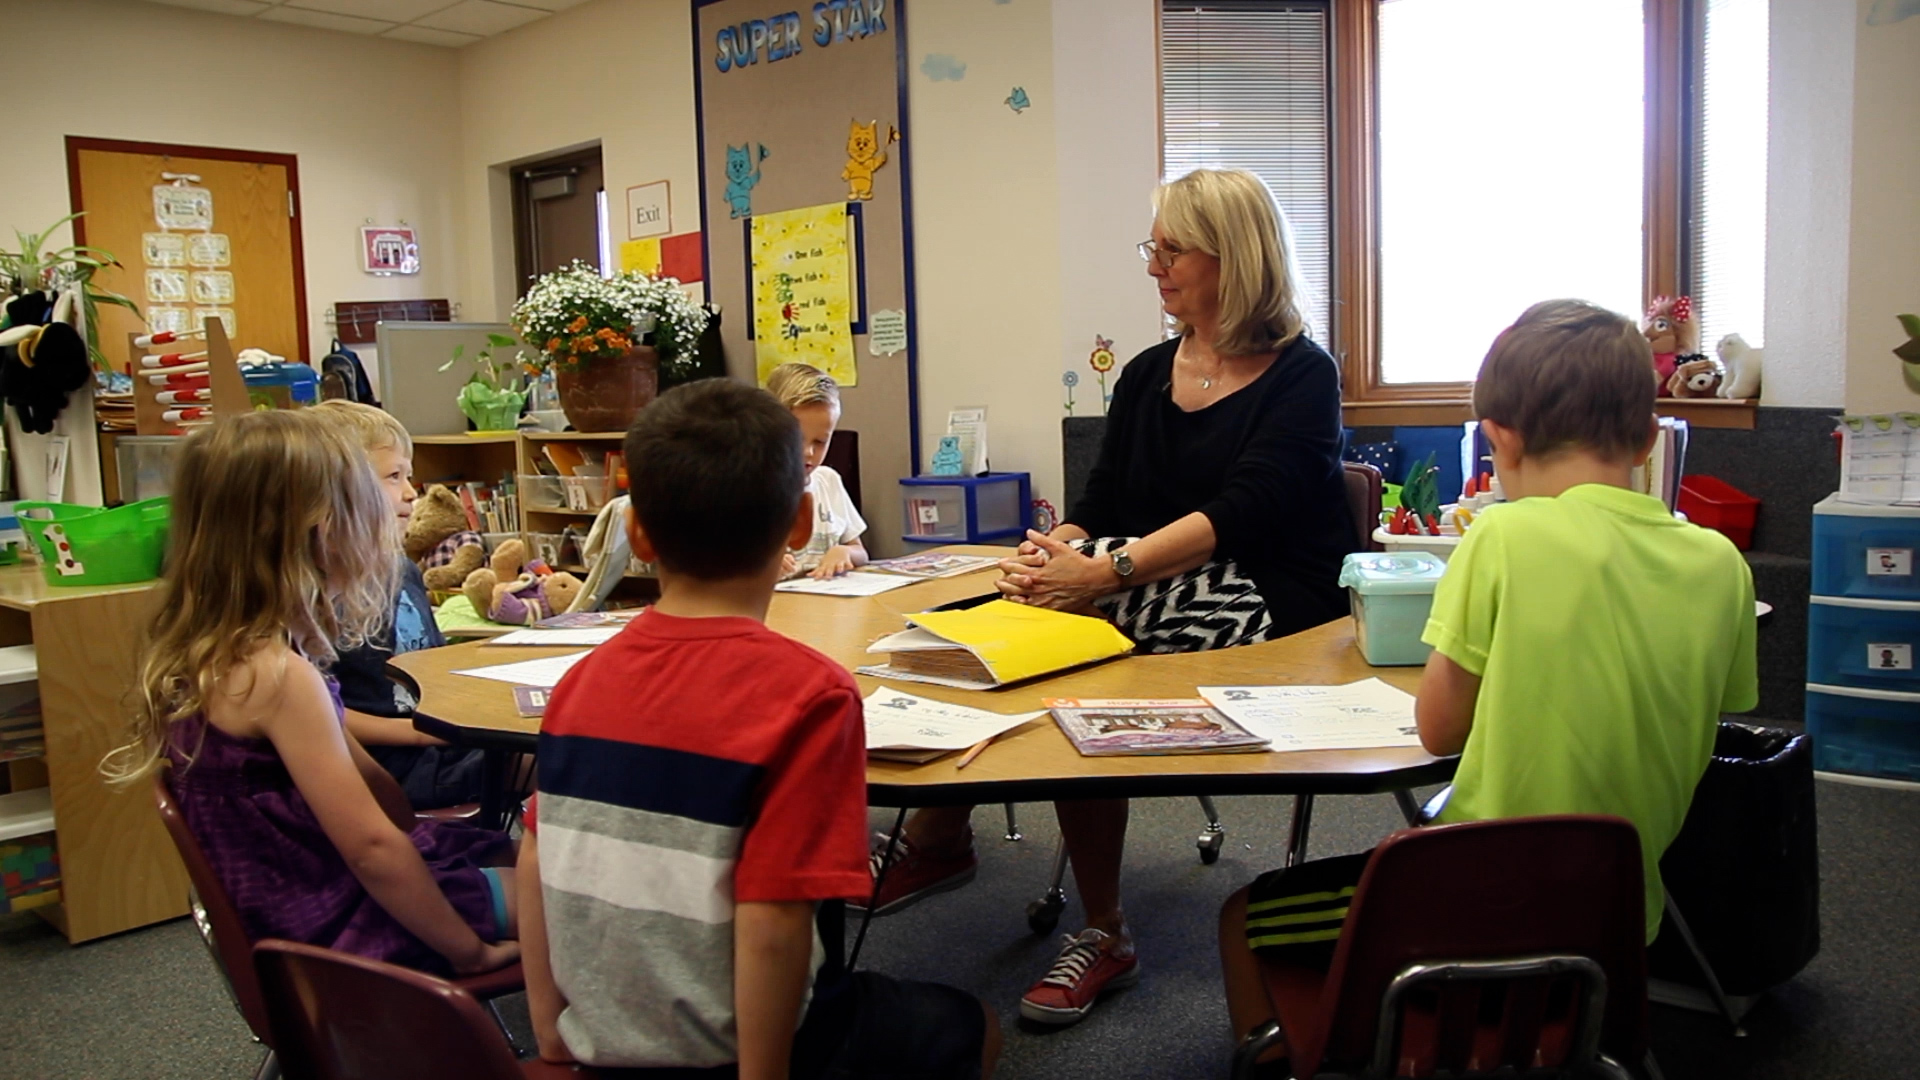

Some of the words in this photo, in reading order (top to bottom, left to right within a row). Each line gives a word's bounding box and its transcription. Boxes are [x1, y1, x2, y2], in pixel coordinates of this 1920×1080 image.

[715, 11, 802, 73] SUPER
[812, 0, 887, 47] STAR
[636, 204, 661, 224] Exit
[795, 250, 808, 260] One
[810, 247, 823, 258] fish
[804, 271, 818, 282] fish
[813, 297, 826, 307] fish
[815, 323, 828, 332] fish
